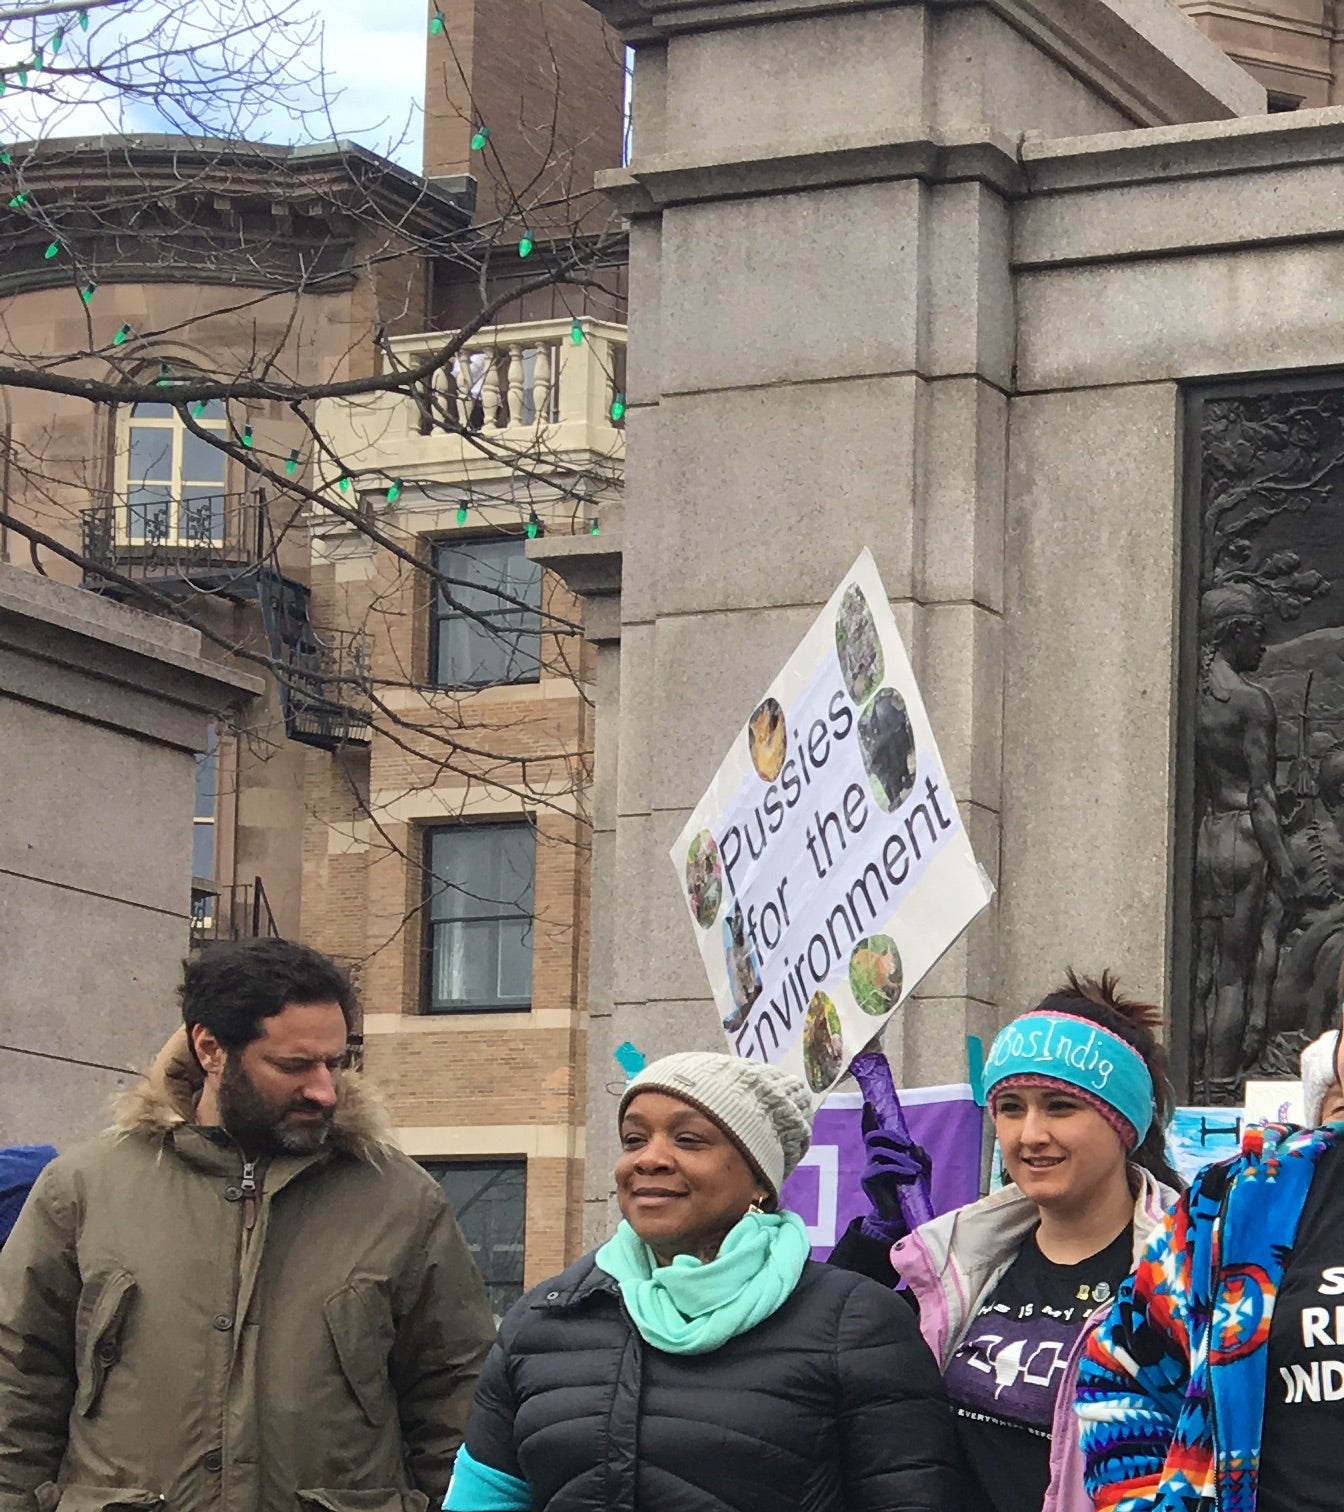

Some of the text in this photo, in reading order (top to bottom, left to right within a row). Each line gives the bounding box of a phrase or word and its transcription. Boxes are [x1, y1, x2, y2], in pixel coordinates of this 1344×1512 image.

[719, 687, 855, 896] Pussies
[741, 786, 867, 966] for the
[737, 776, 951, 1064] Environment
